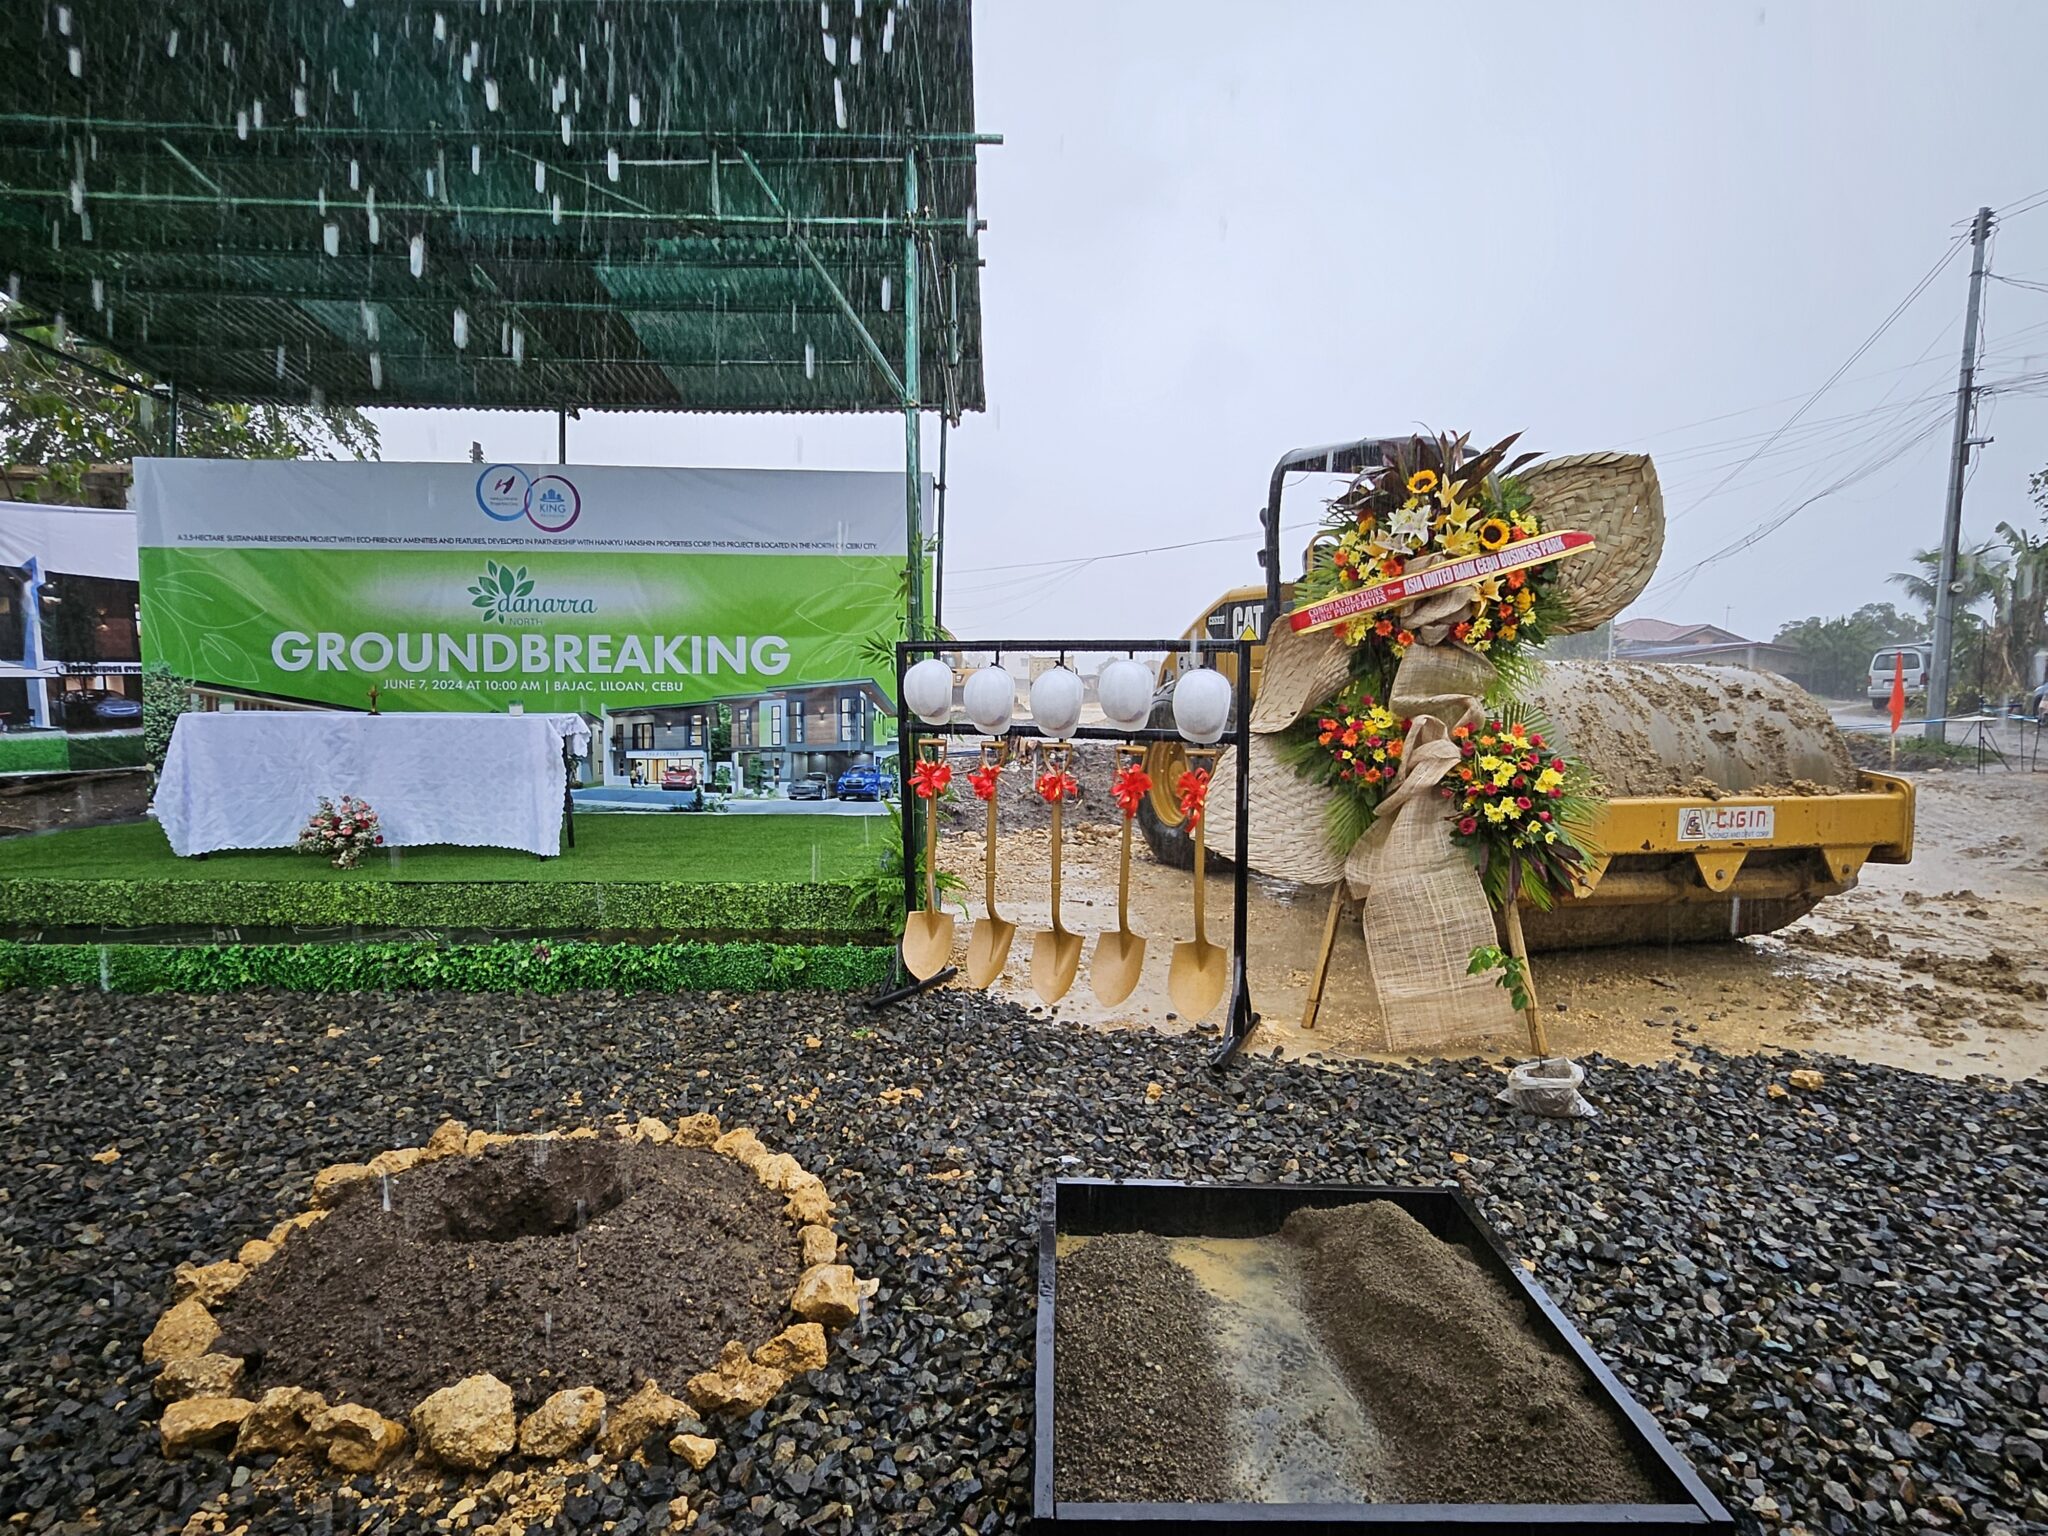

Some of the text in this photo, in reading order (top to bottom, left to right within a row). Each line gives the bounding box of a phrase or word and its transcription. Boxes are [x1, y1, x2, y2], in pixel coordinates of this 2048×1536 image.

[540, 504, 566, 513] KING
[227, 534, 268, 542] SUSTAINABLE
[269, 535, 309, 543] RESIDENTIAL
[310, 535, 337, 543] PROJECT
[357, 536, 402, 544] ECO-FRIENDLY
[439, 537, 454, 545] AND
[534, 538, 576, 546] PARTNERSHIP
[726, 541, 754, 549] PROJECT
[761, 541, 789, 549] LOCATED
[811, 542, 834, 550] NORTH
[845, 542, 862, 550] CEBU
[1403, 576, 1425, 596] ASIA
[1423, 569, 1453, 589] UNITED
[1453, 561, 1477, 581] BANK
[1476, 555, 1499, 574] CEBU
[1499, 543, 1541, 567] BUSINESS
[1540, 536, 1566, 556] PARK
[498, 595, 598, 613] danarra
[1308, 587, 1384, 617] CONGRATULATIONS
[1311, 595, 1387, 625] KING PROPERTIES
[509, 617, 542, 626] NORTH
[1232, 605, 1264, 641] CAT
[271, 632, 792, 675] GROUNDBREAKING
[383, 679, 683, 693] JUNE 7, 2024 AT 10:00 AM BAJAC, LILOAN, CEBU
